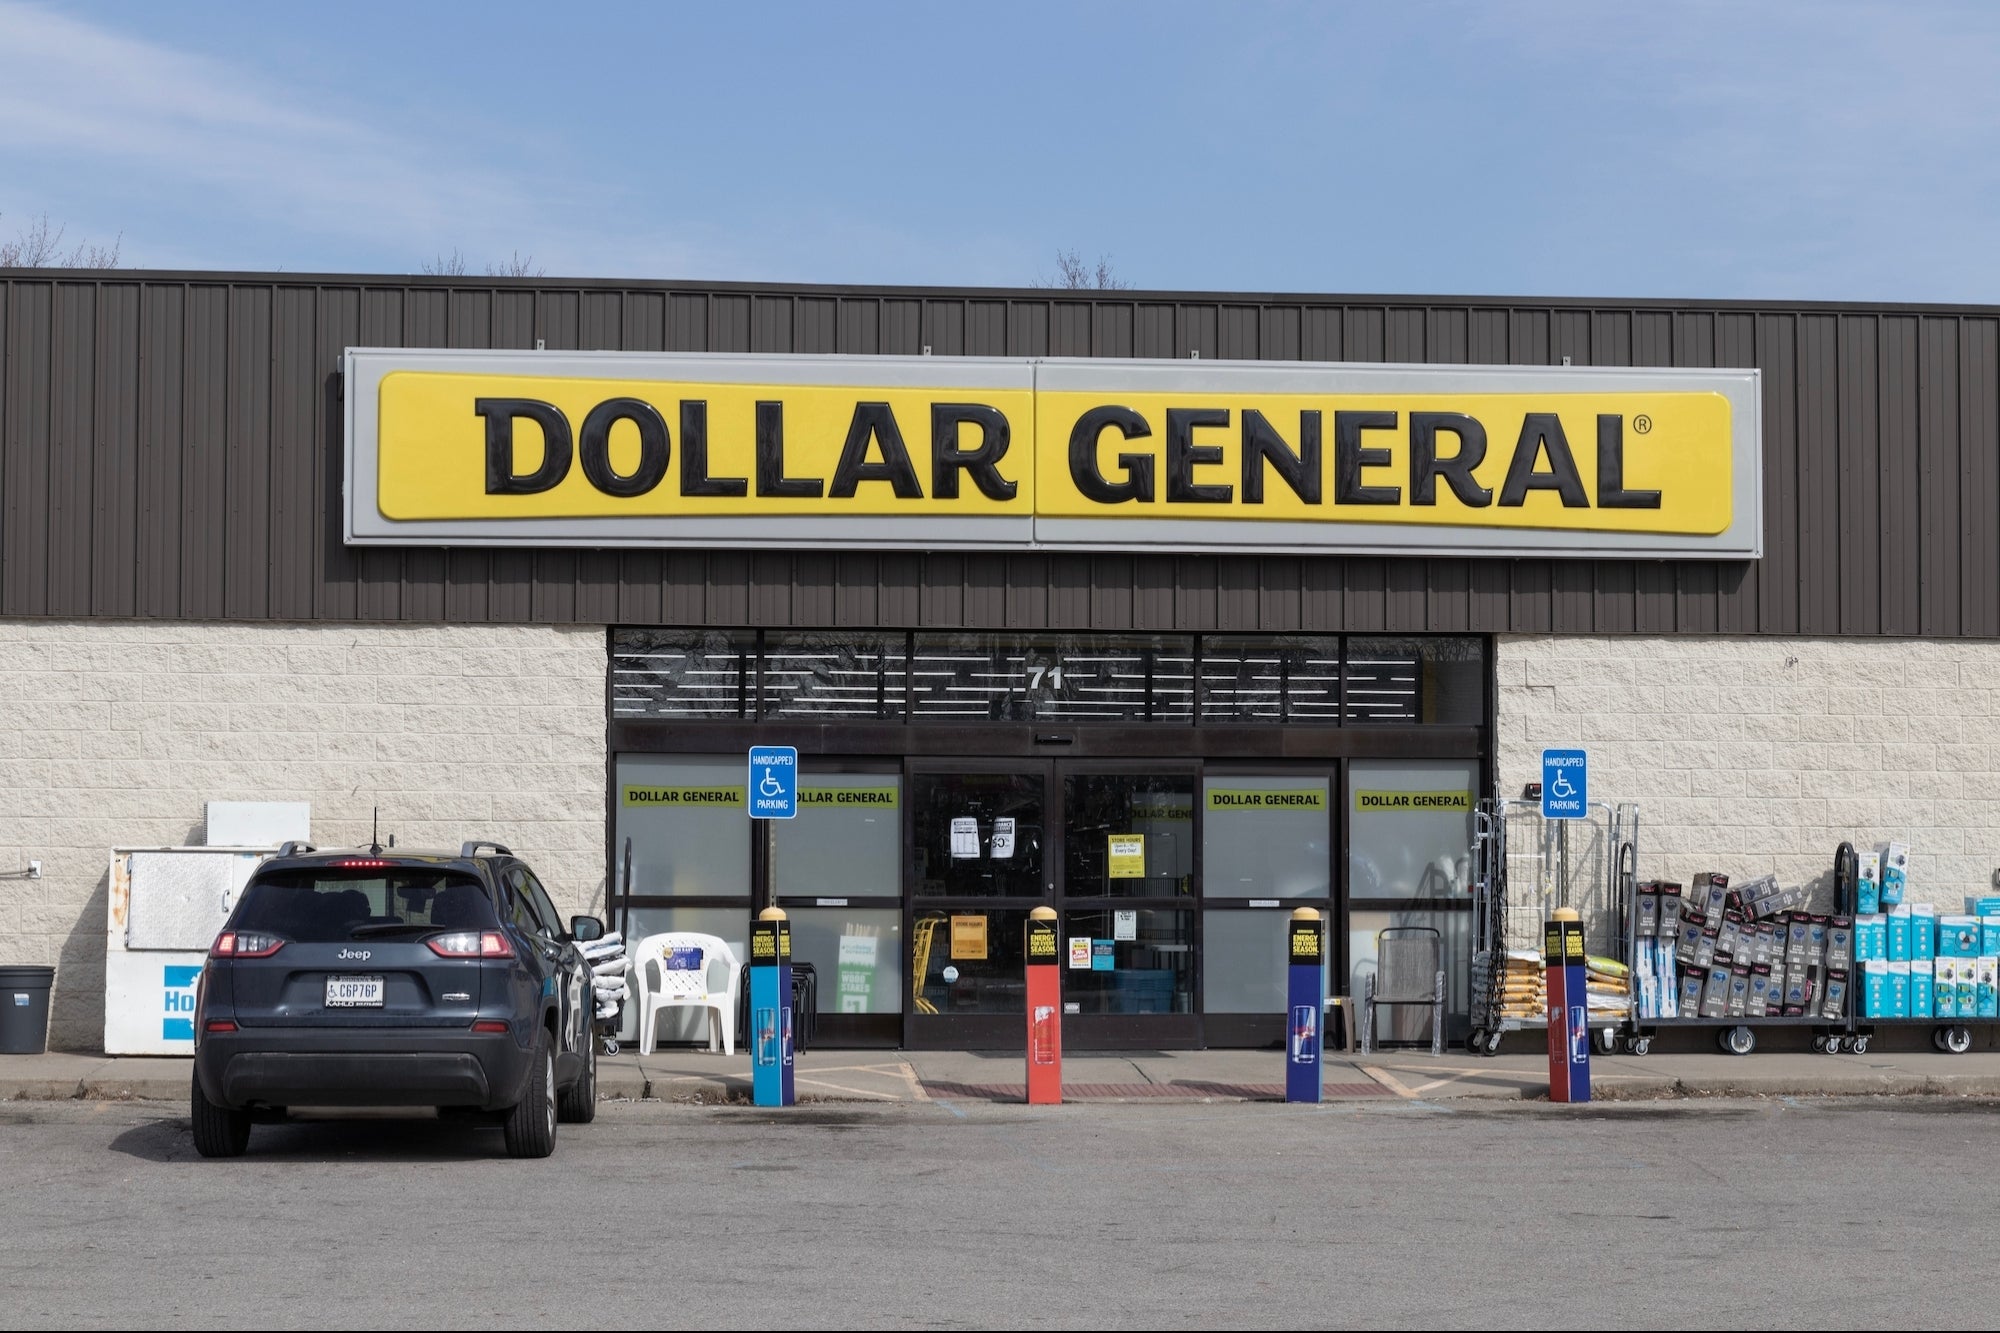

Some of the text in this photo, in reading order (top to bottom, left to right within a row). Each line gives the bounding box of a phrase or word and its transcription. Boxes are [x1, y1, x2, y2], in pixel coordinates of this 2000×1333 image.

[475, 397, 1018, 501] DOLLAR
[1026, 666, 1062, 690] 71
[753, 756, 793, 766] HANDICAPPED
[1545, 757, 1584, 767] HANDICAPPED
[629, 791, 739, 803] DOLLAR GENERAL
[836, 792, 893, 803] GENERAL
[1213, 794, 1320, 805] DOLLAR GENERAL
[1361, 796, 1467, 807] DOLLAR GENERAL
[757, 799, 789, 809] PARKING
[1550, 800, 1580, 810] PARKING
[753, 935, 775, 943] ENERGY
[337, 949, 371, 961] Jeep
[339, 984, 377, 998] C6P76P
[165, 991, 194, 1011] Ho
